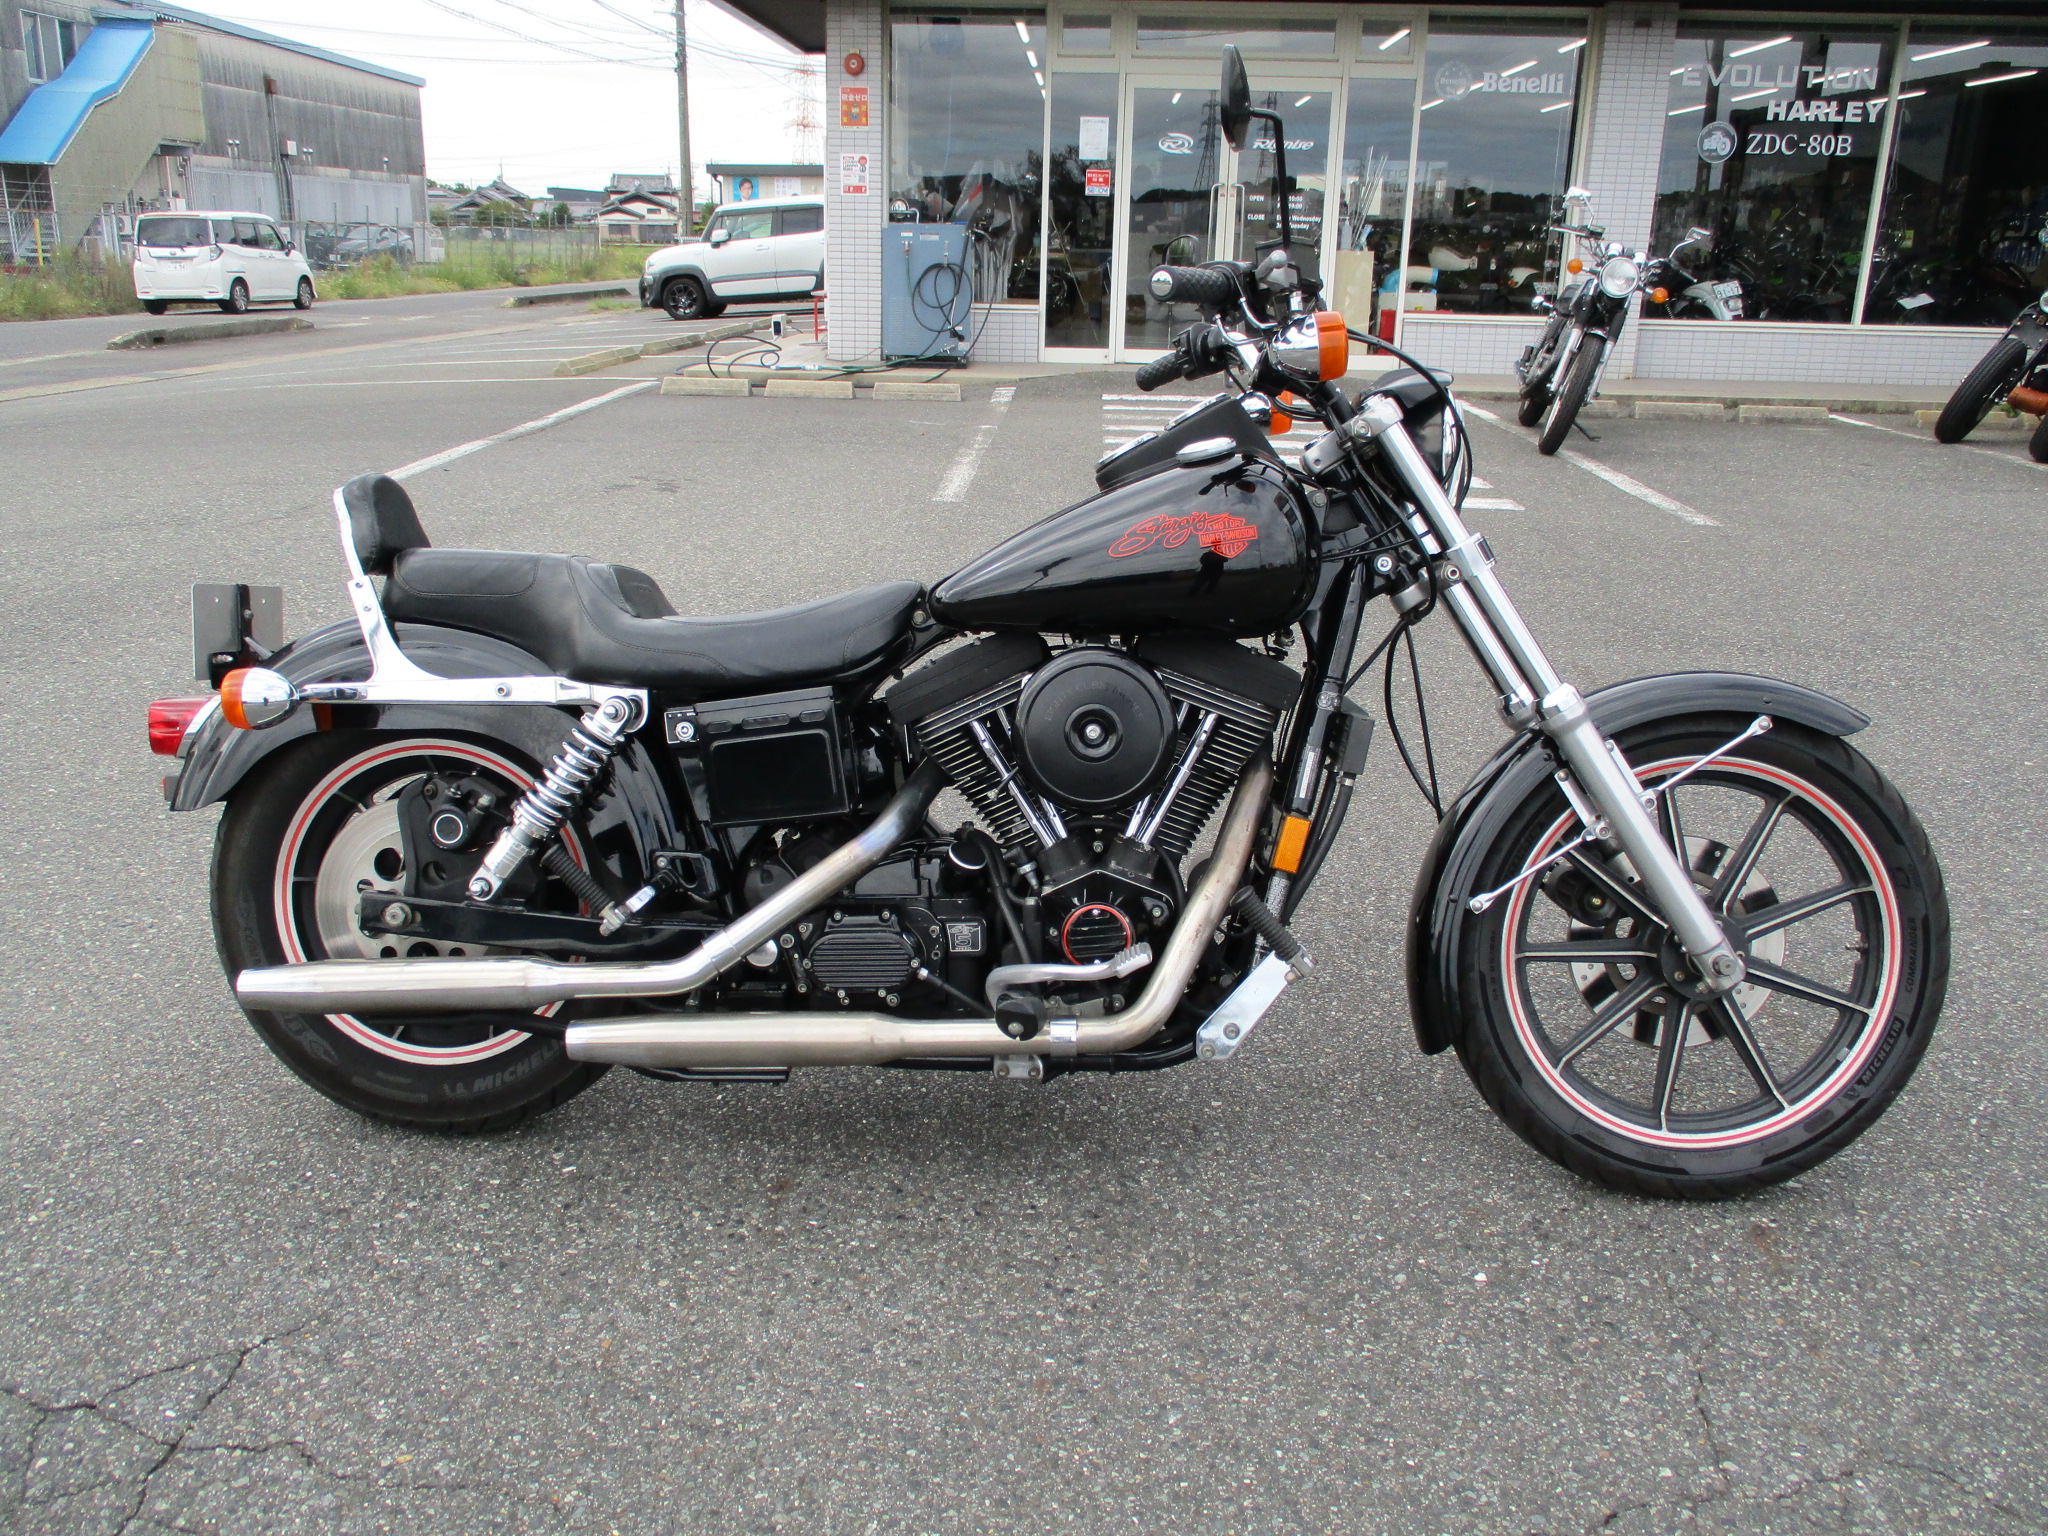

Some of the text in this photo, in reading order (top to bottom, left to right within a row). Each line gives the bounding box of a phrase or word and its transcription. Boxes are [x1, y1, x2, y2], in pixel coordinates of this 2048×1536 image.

[1482, 71, 1564, 94] Benelli
[1682, 64, 1879, 90] EVOLUTION
[1766, 100, 1886, 123] HARLEY
[1745, 133, 1853, 157] ZDC-80B
[1247, 213, 1266, 221] CLOSE
[1292, 215, 1322, 223] Wednesday
[1201, 527, 1257, 545] HARLEY-DAVIDSON
[1208, 518, 1245, 531] MOTOR
[1213, 541, 1247, 555] CYCLES
[1861, 1020, 1902, 1084] MICHELIN
[473, 1040, 562, 1093] MICHELI
